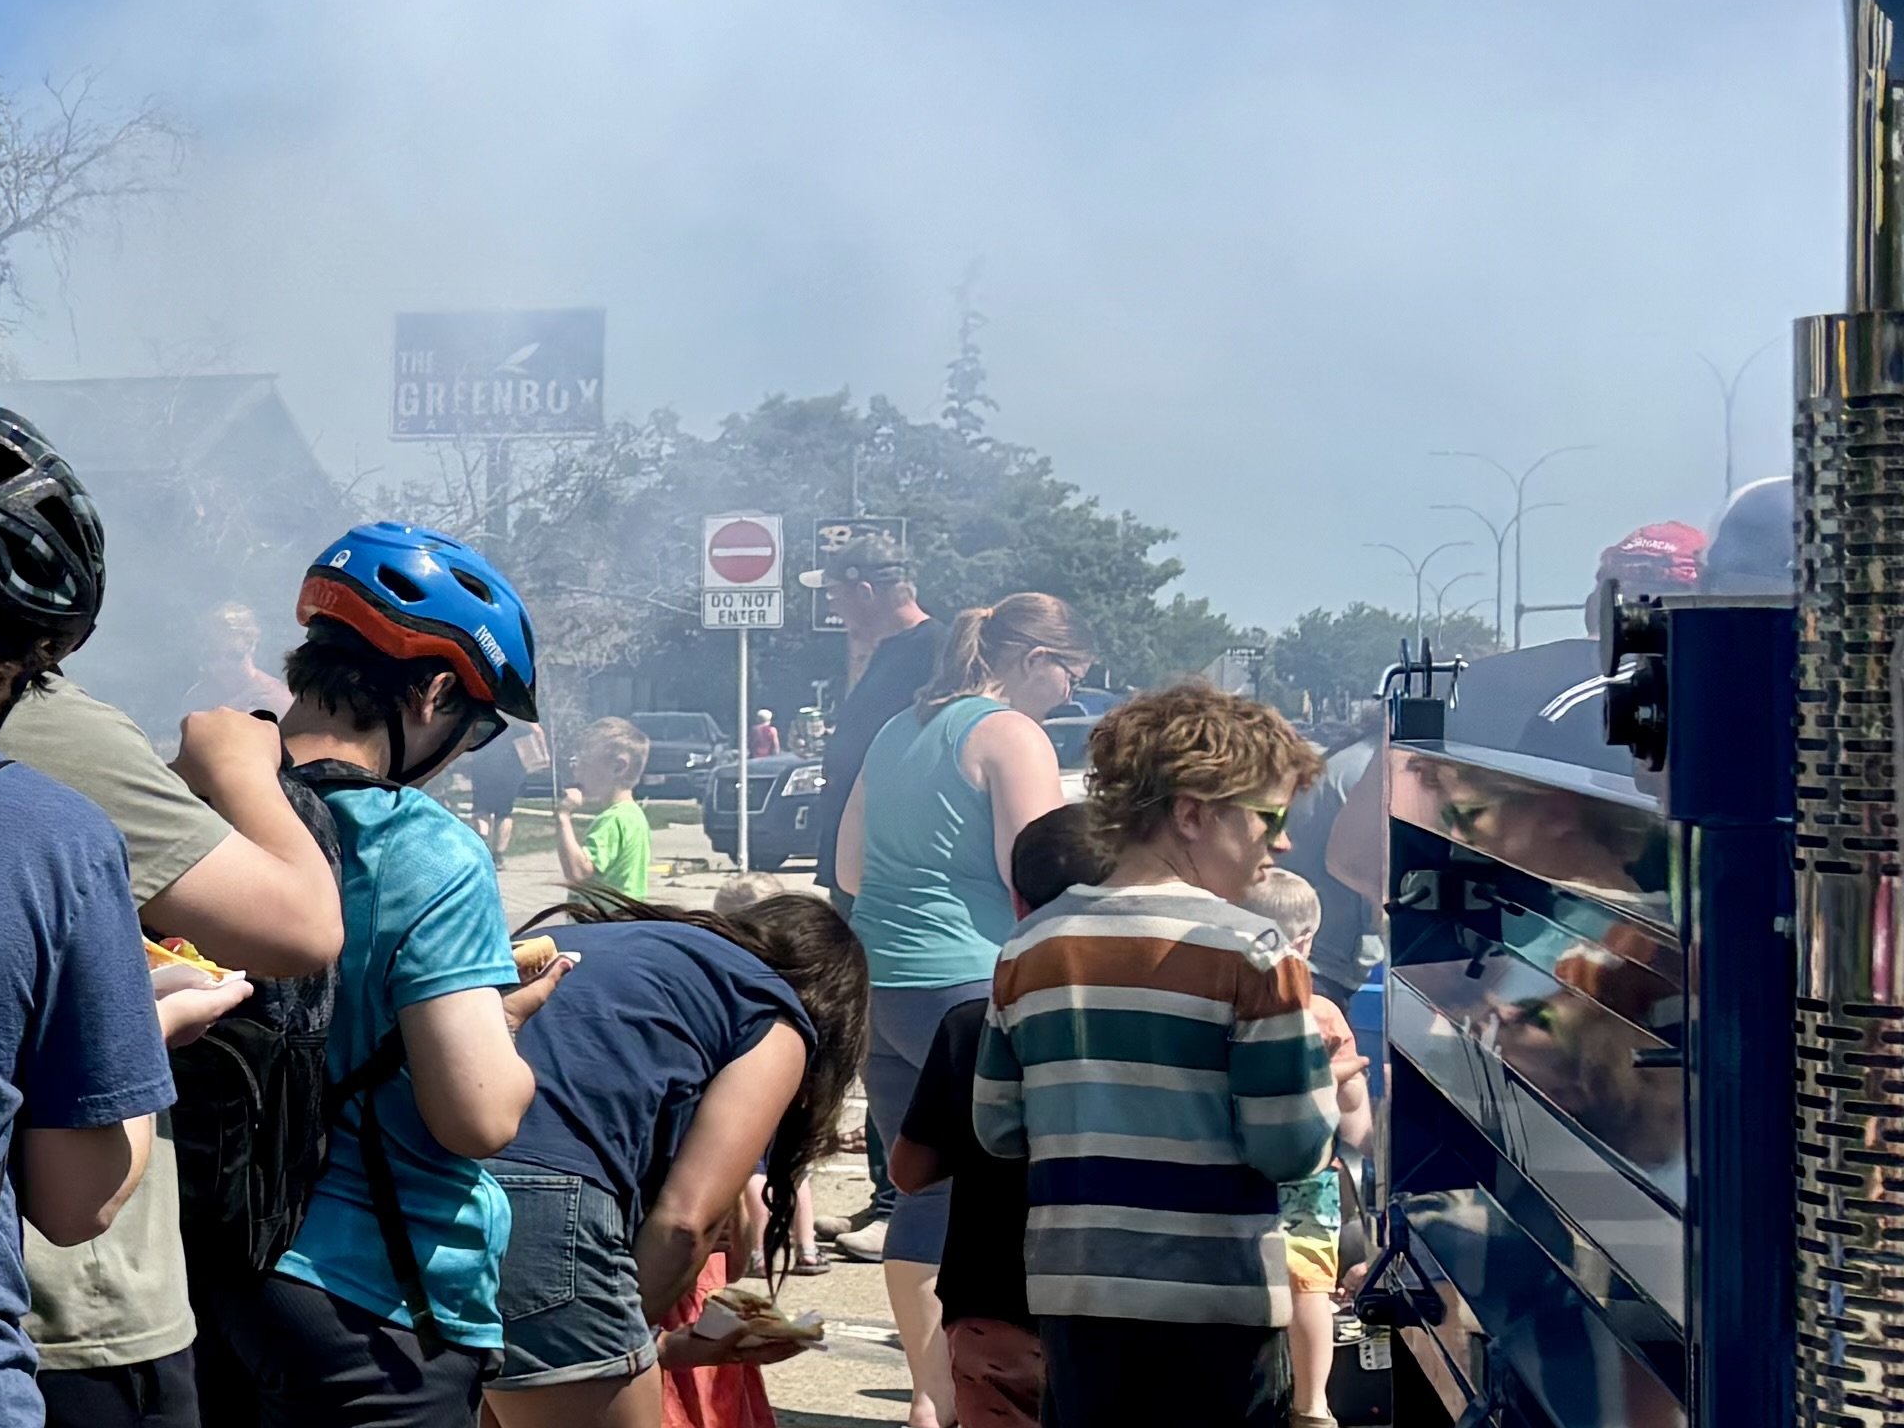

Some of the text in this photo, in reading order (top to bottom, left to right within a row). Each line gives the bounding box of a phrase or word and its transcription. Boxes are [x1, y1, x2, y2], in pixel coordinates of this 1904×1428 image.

[398, 350, 435, 374] THE
[397, 378, 598, 417] GREENBOX
[711, 590, 775, 608] DO NOT
[718, 609, 766, 624] ENTER
